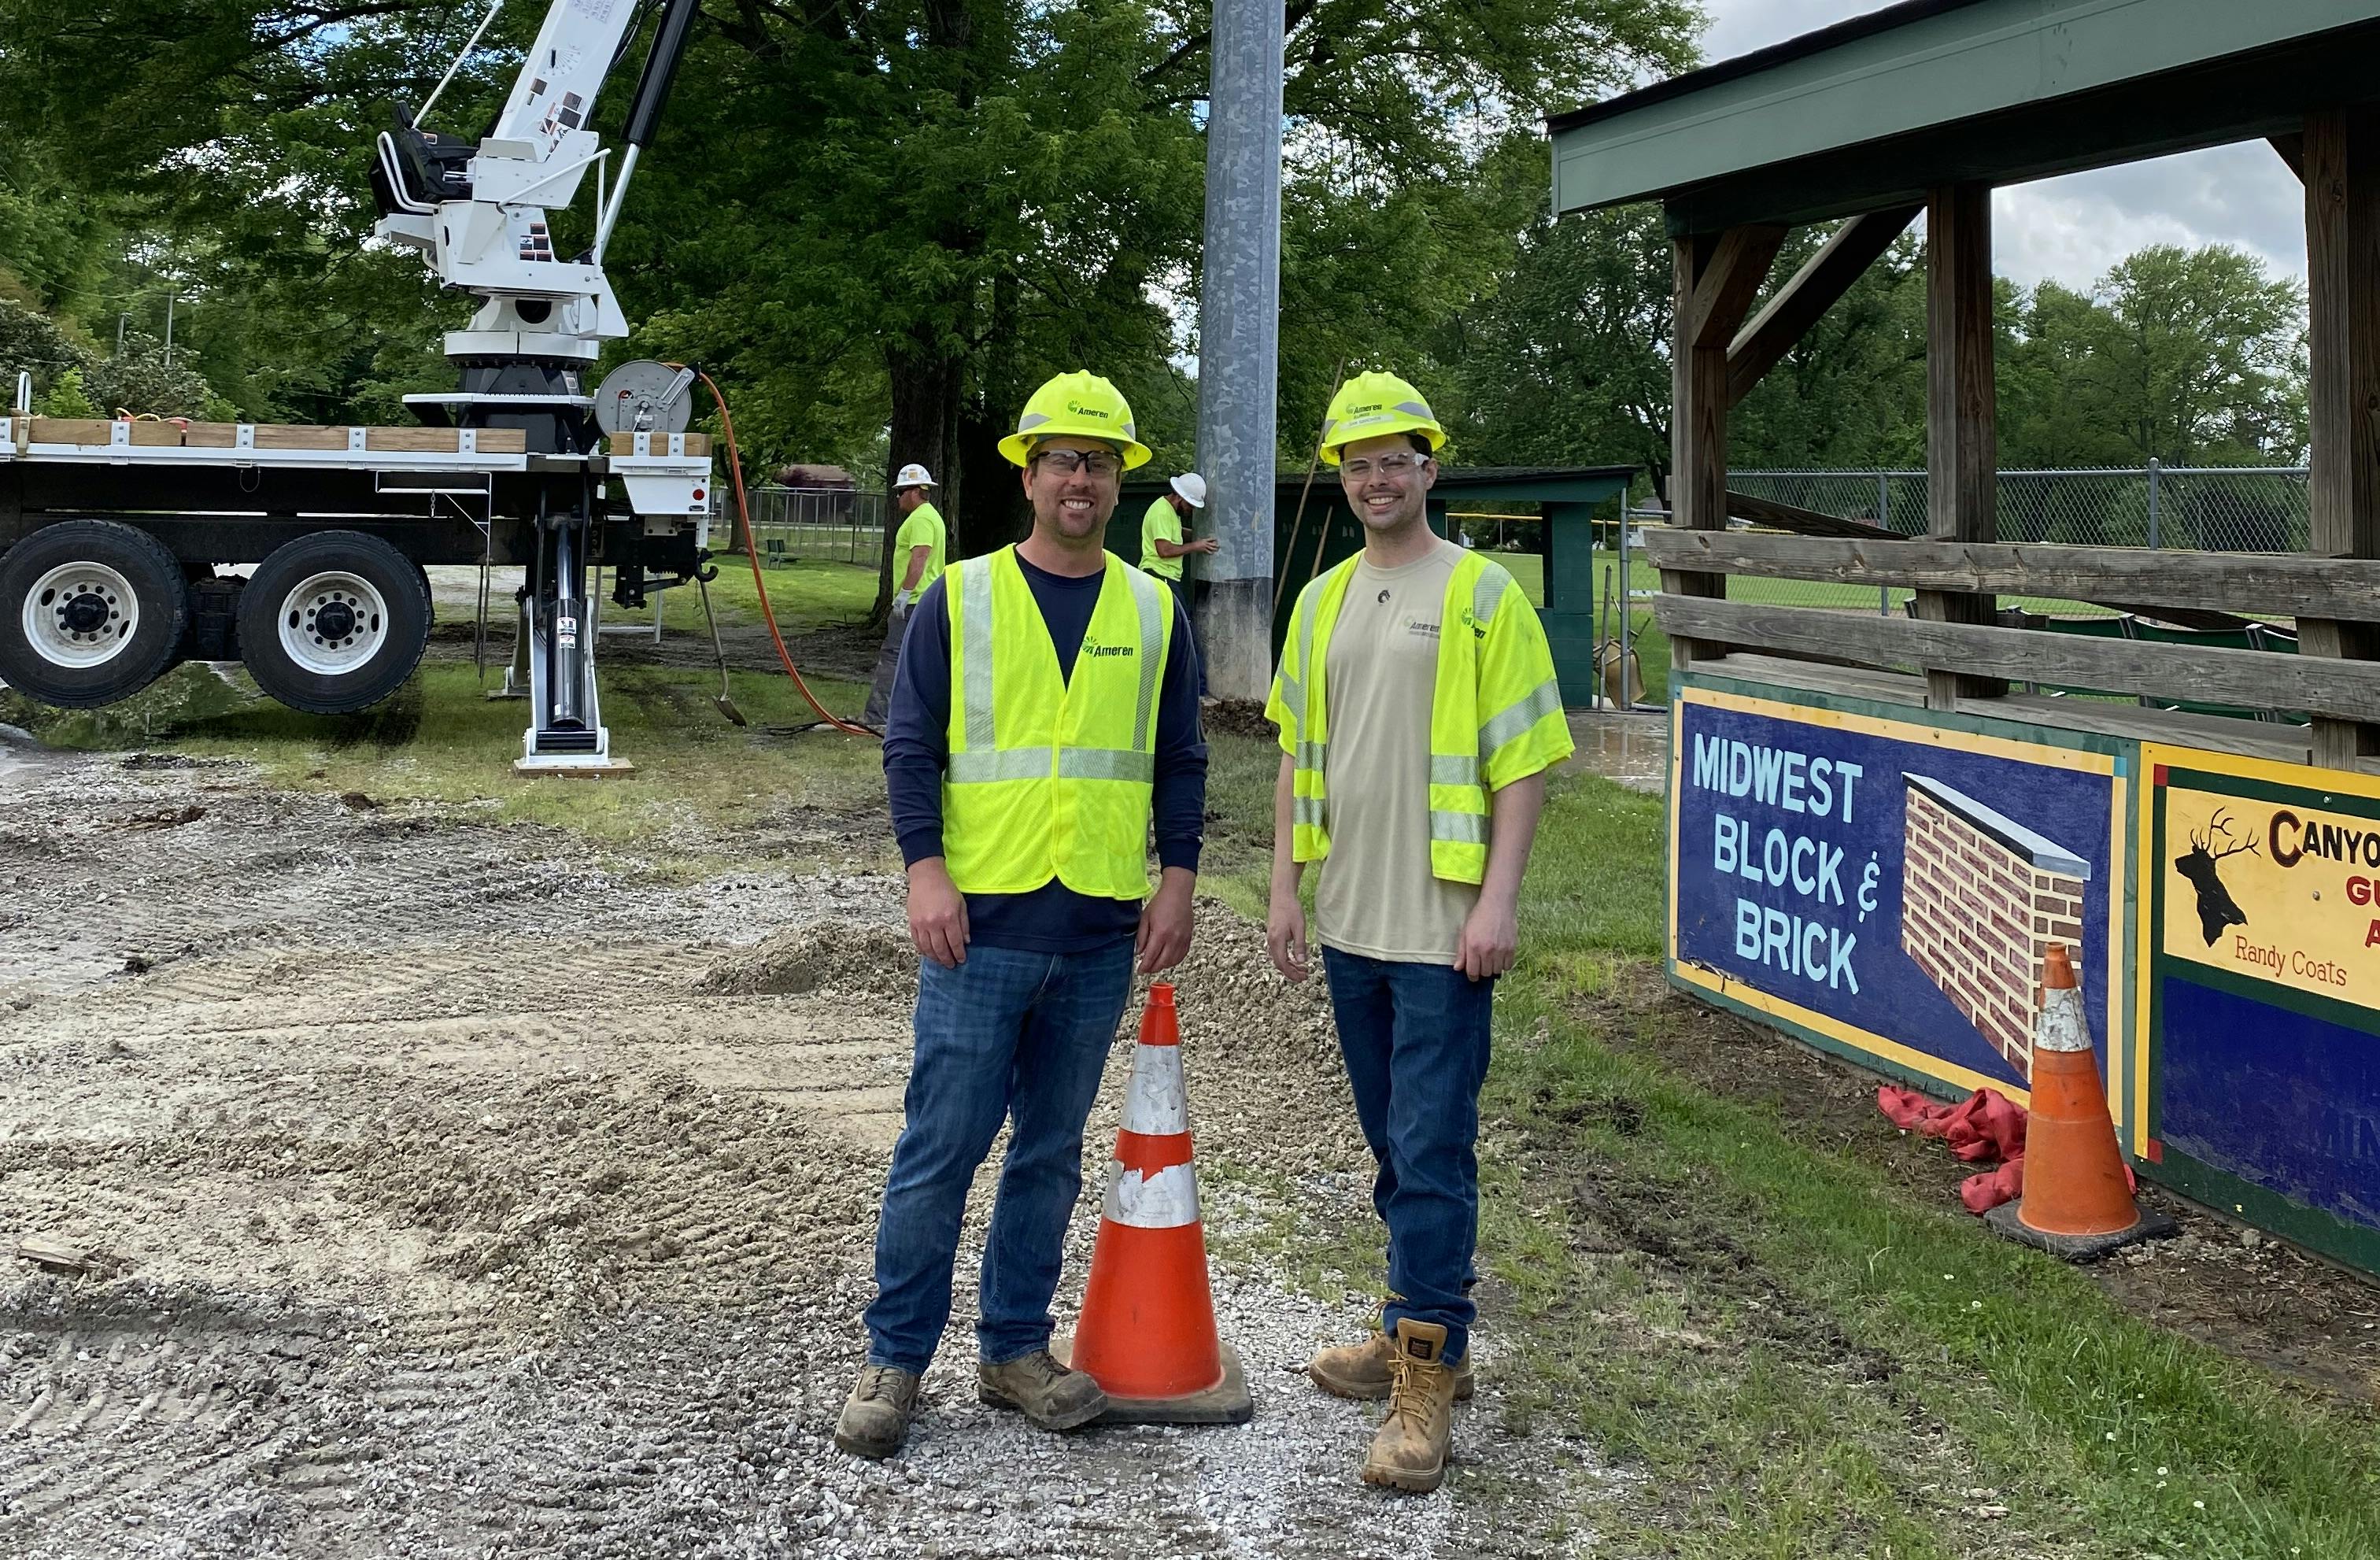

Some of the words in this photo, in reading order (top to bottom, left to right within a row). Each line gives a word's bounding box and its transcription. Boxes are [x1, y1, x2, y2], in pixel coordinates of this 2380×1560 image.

[1077, 408, 1108, 419] Ameren
[1354, 405, 1382, 414] Ameren
[1410, 622, 1439, 632] Ameren
[1093, 645, 1133, 657] Ameren
[1693, 732, 1864, 823] MIDWEST
[1714, 812, 1845, 906] BLOCK
[1857, 850, 1881, 923] &
[1735, 897, 1860, 995] BRICK
[2235, 934, 2286, 978] Randy
[2292, 950, 2348, 986] Coats
